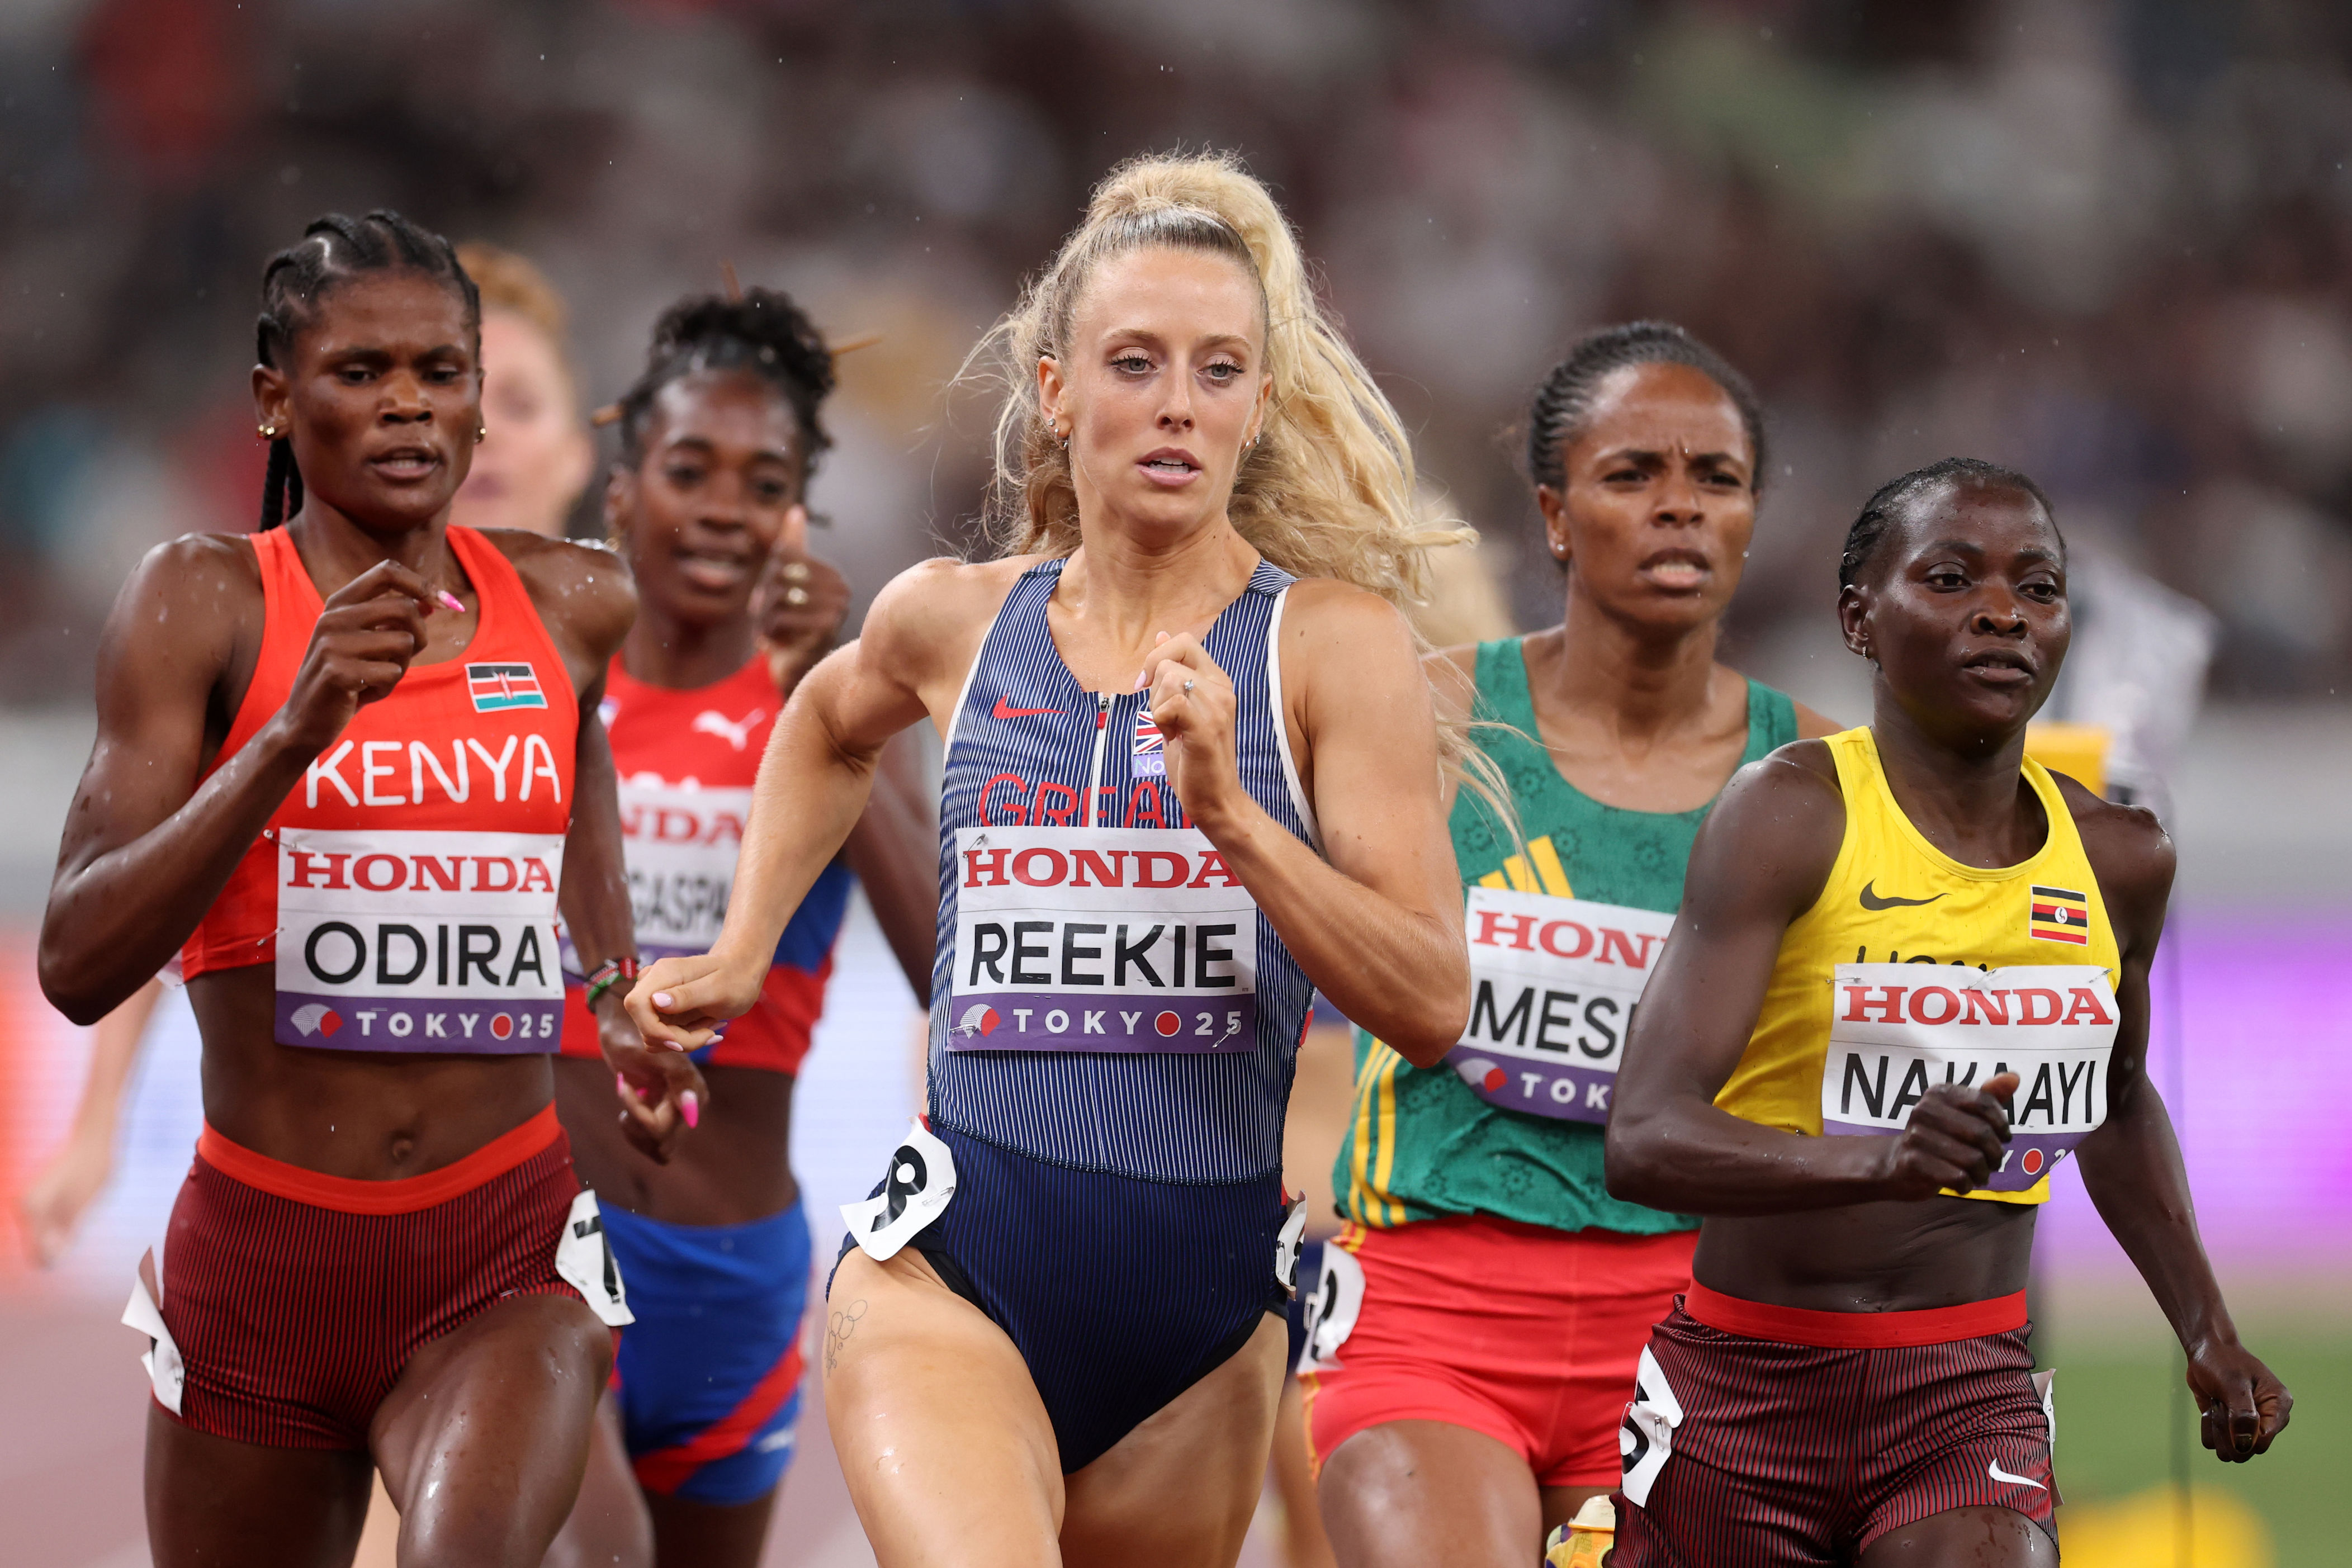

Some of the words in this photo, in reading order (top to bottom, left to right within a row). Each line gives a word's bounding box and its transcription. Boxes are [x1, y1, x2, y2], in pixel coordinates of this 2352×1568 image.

[305, 734, 561, 808] KENYA
[979, 773, 1195, 828] GREA
[619, 803, 747, 846] NDA
[286, 851, 554, 892] HONDA
[963, 847, 1242, 888] HONDA
[305, 921, 548, 987] ODIRA
[969, 921, 1237, 988] REEKIE
[1473, 910, 1669, 970] HON
[1469, 979, 1638, 1059] MES
[1841, 986, 2113, 1026] HONDA
[1521, 1072, 1610, 1110] TOK
[870, 1145, 927, 1233] 9
[574, 1214, 621, 1304] 7
